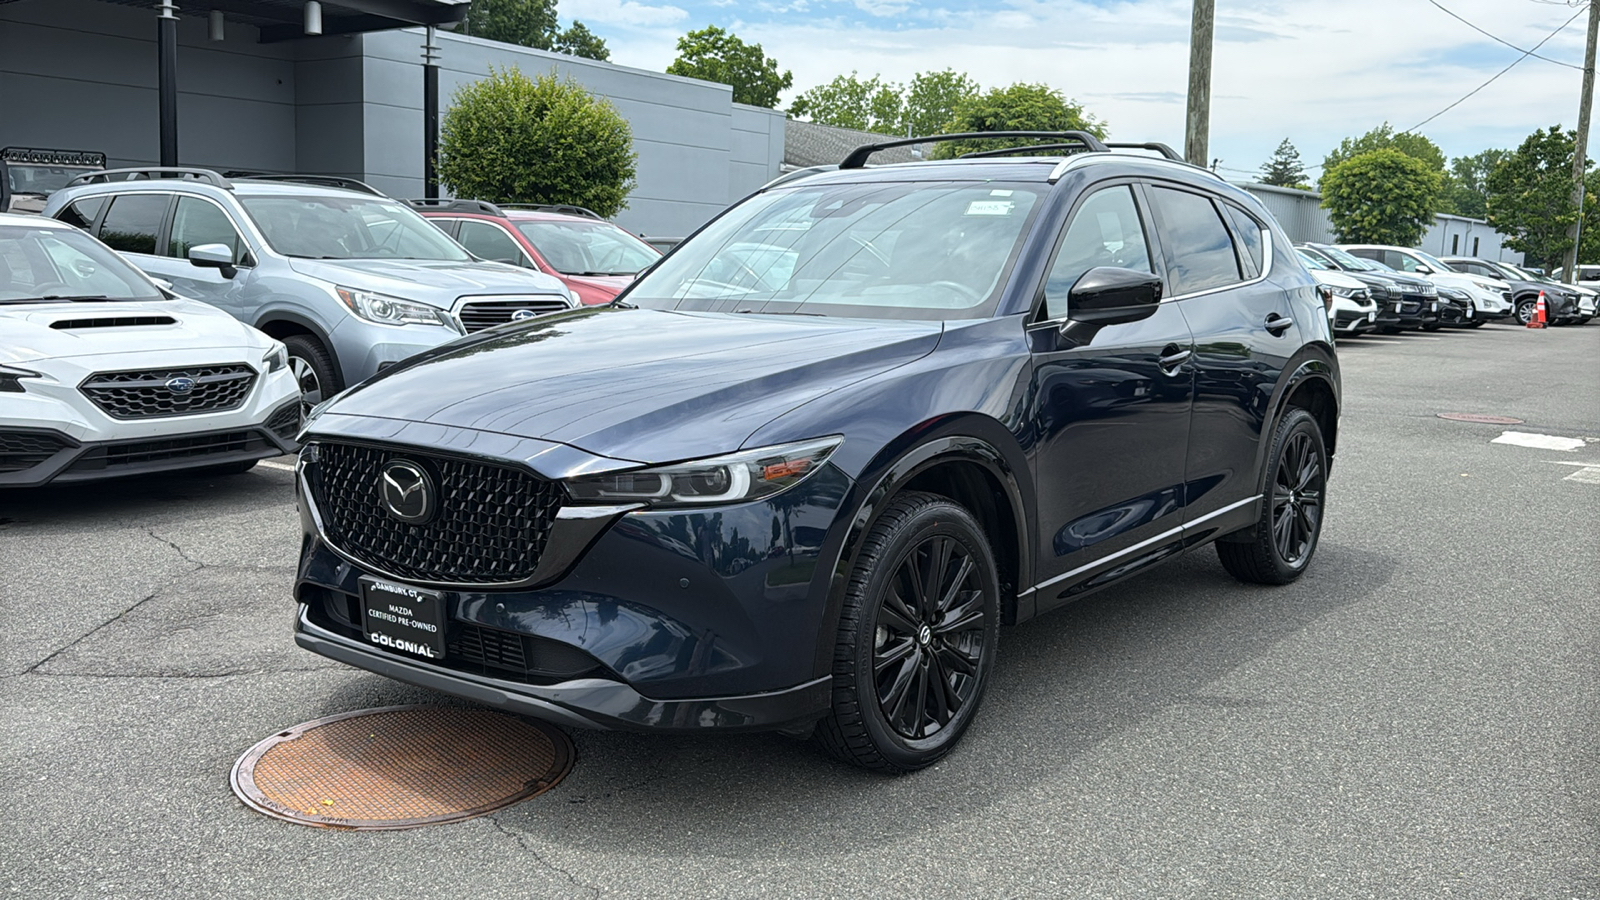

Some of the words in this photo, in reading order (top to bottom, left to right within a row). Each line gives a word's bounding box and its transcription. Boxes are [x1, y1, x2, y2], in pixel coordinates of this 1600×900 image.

[408, 589, 418, 598] CT
[389, 604, 413, 616] MAZDA
[368, 609, 397, 622] CERTIFIED
[398, 617, 437, 632] PRE-OWNED
[371, 633, 434, 658] COLONIAL
